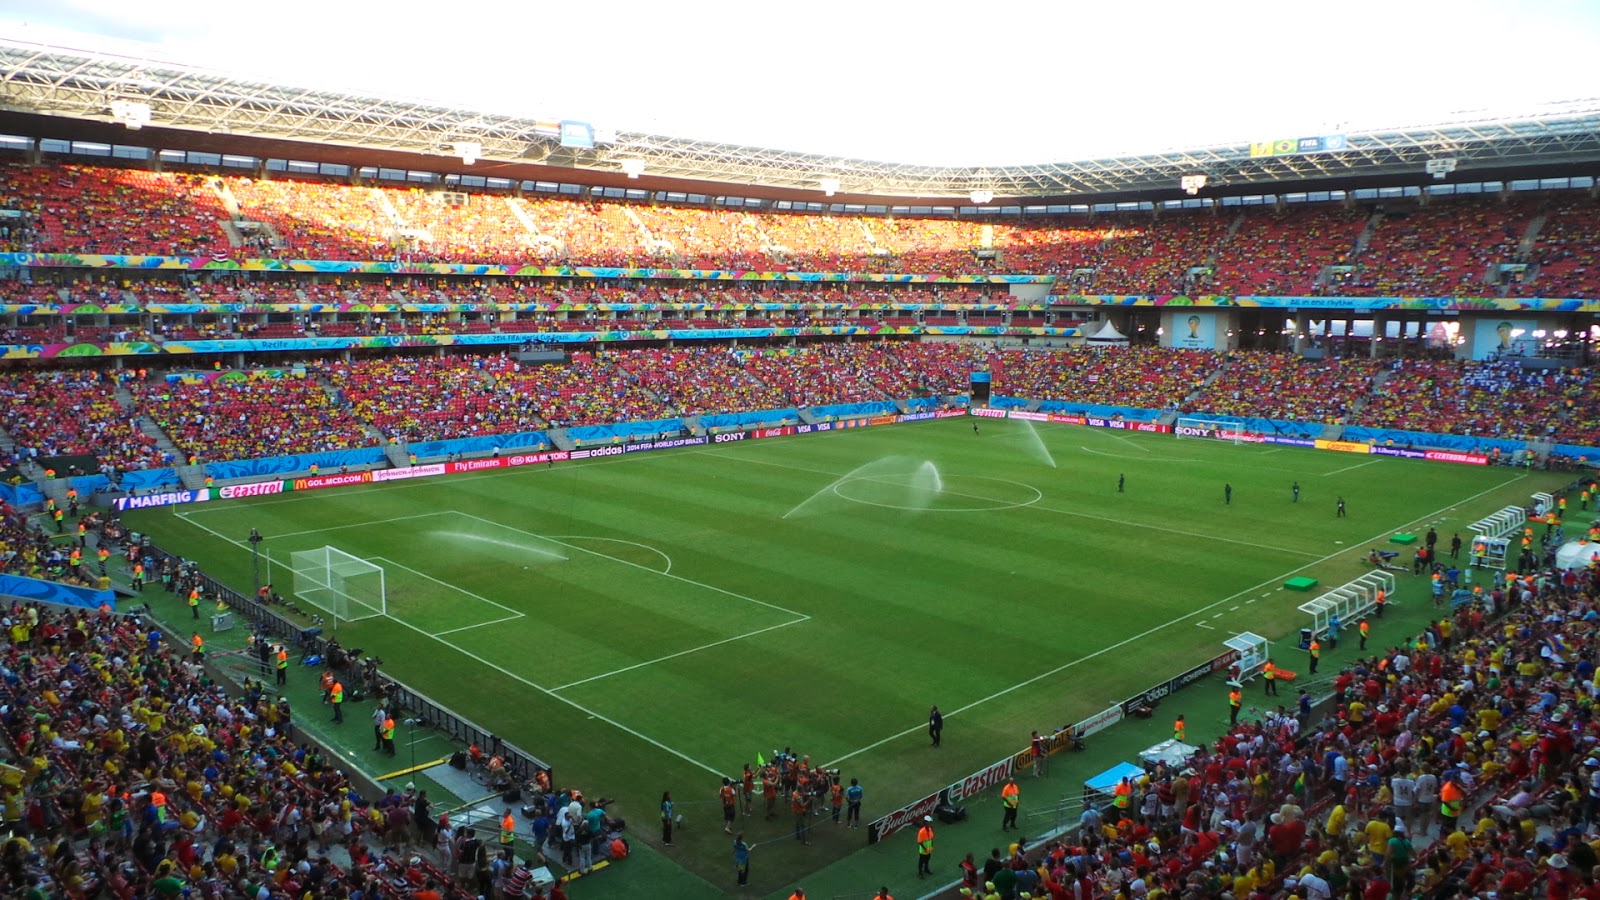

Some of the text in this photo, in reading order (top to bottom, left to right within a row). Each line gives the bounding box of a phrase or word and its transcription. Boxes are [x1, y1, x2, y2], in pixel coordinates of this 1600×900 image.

[1300, 139, 1318, 147] FIFA
[817, 423, 831, 431] VISA
[1088, 418, 1104, 426] VISA
[1109, 420, 1125, 428] VISA
[797, 425, 811, 433] VISA
[1174, 426, 1210, 436] SONY
[654, 440, 674, 448] WORLD
[685, 437, 704, 445] BRAZIL
[715, 432, 746, 443] SONY
[591, 445, 622, 457] adidas
[1377, 447, 1400, 456] Liberty
[525, 453, 538, 463] KIA
[454, 459, 500, 471] Fly Emirates
[307, 474, 362, 487] GOL.MCD.COM
[233, 481, 282, 498] Castrol
[130, 491, 192, 508] MARFRIG
[962, 758, 1011, 798] Castrol
[874, 792, 942, 843] Budweiser
